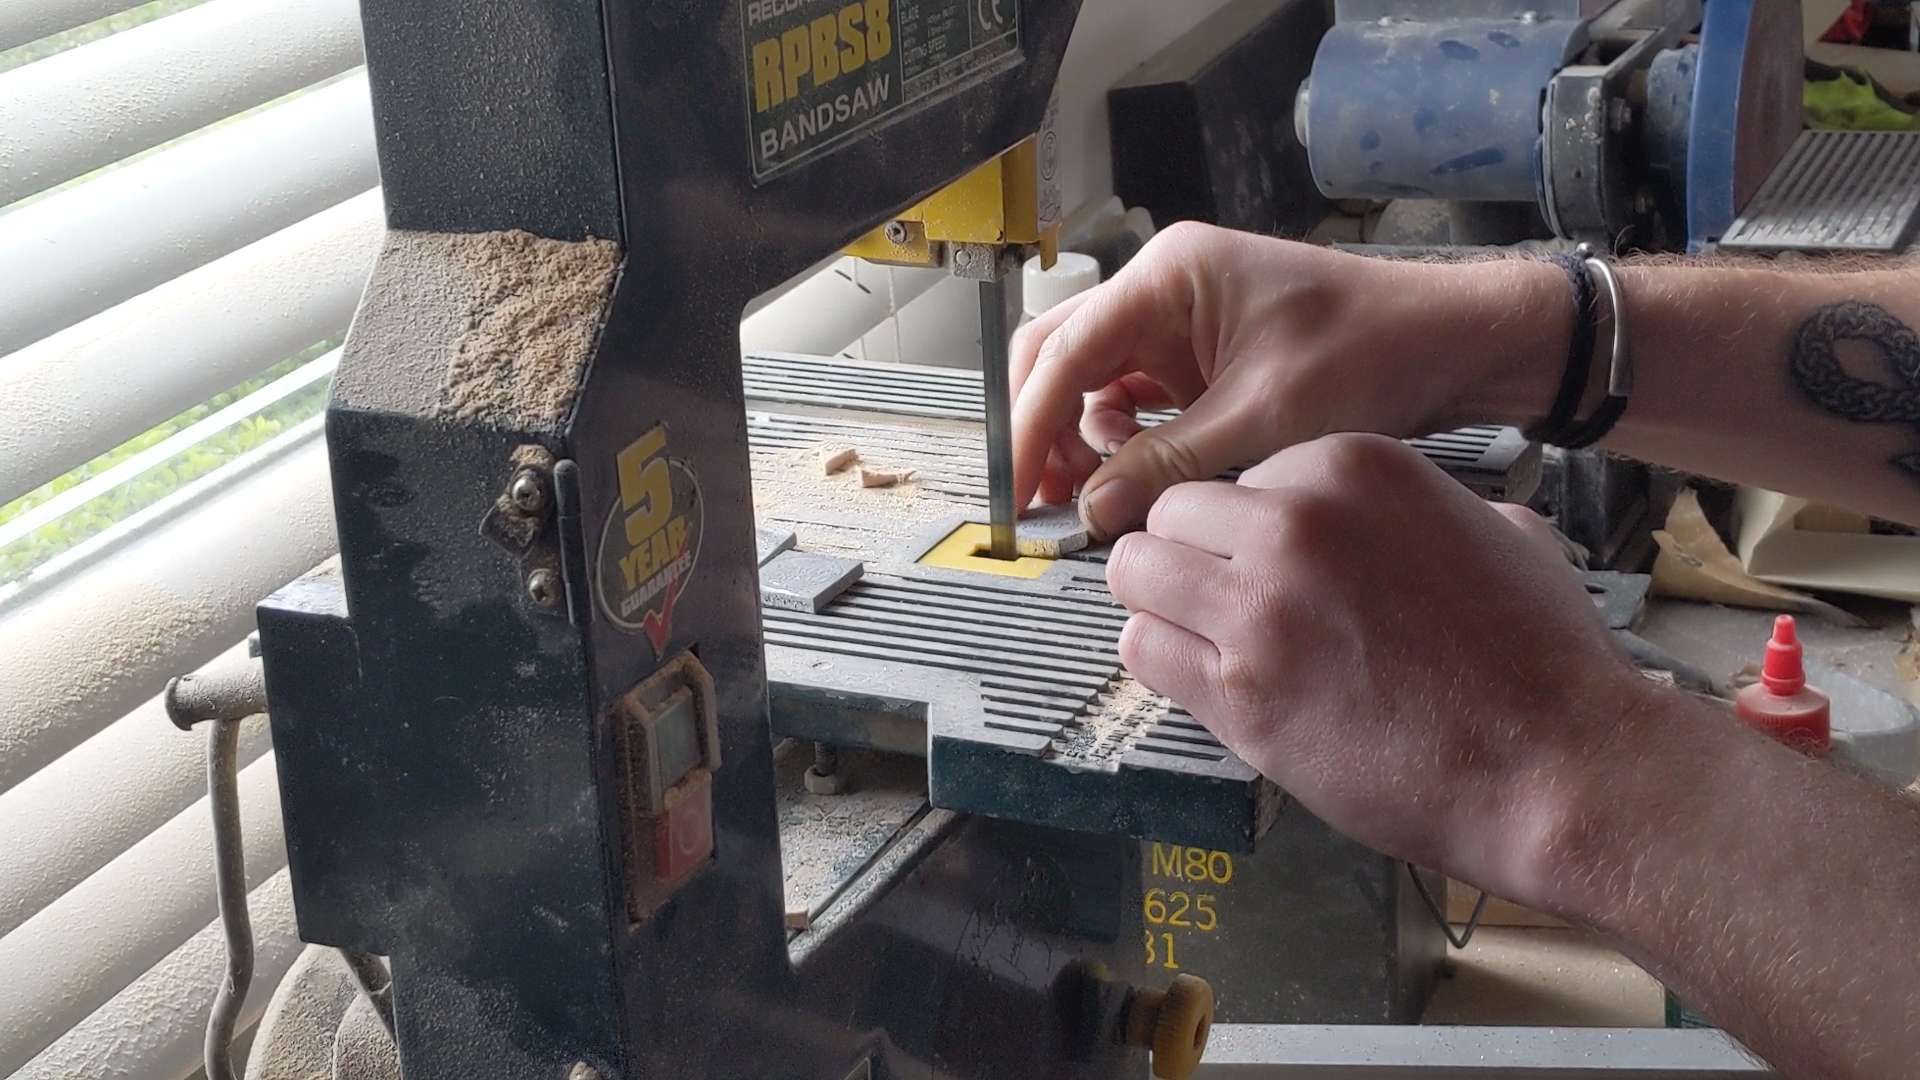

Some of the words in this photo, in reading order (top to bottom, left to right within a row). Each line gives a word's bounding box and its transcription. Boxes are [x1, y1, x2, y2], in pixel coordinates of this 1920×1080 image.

[748, 0, 810, 26] RECO
[752, 0, 892, 113] RPBS8
[760, 73, 890, 160] BANDSAW
[617, 425, 673, 546] 5
[618, 514, 689, 592] YEAR
[620, 549, 692, 618] GUARANTEE
[1151, 841, 1233, 885] M80
[1143, 887, 1218, 931] 625
